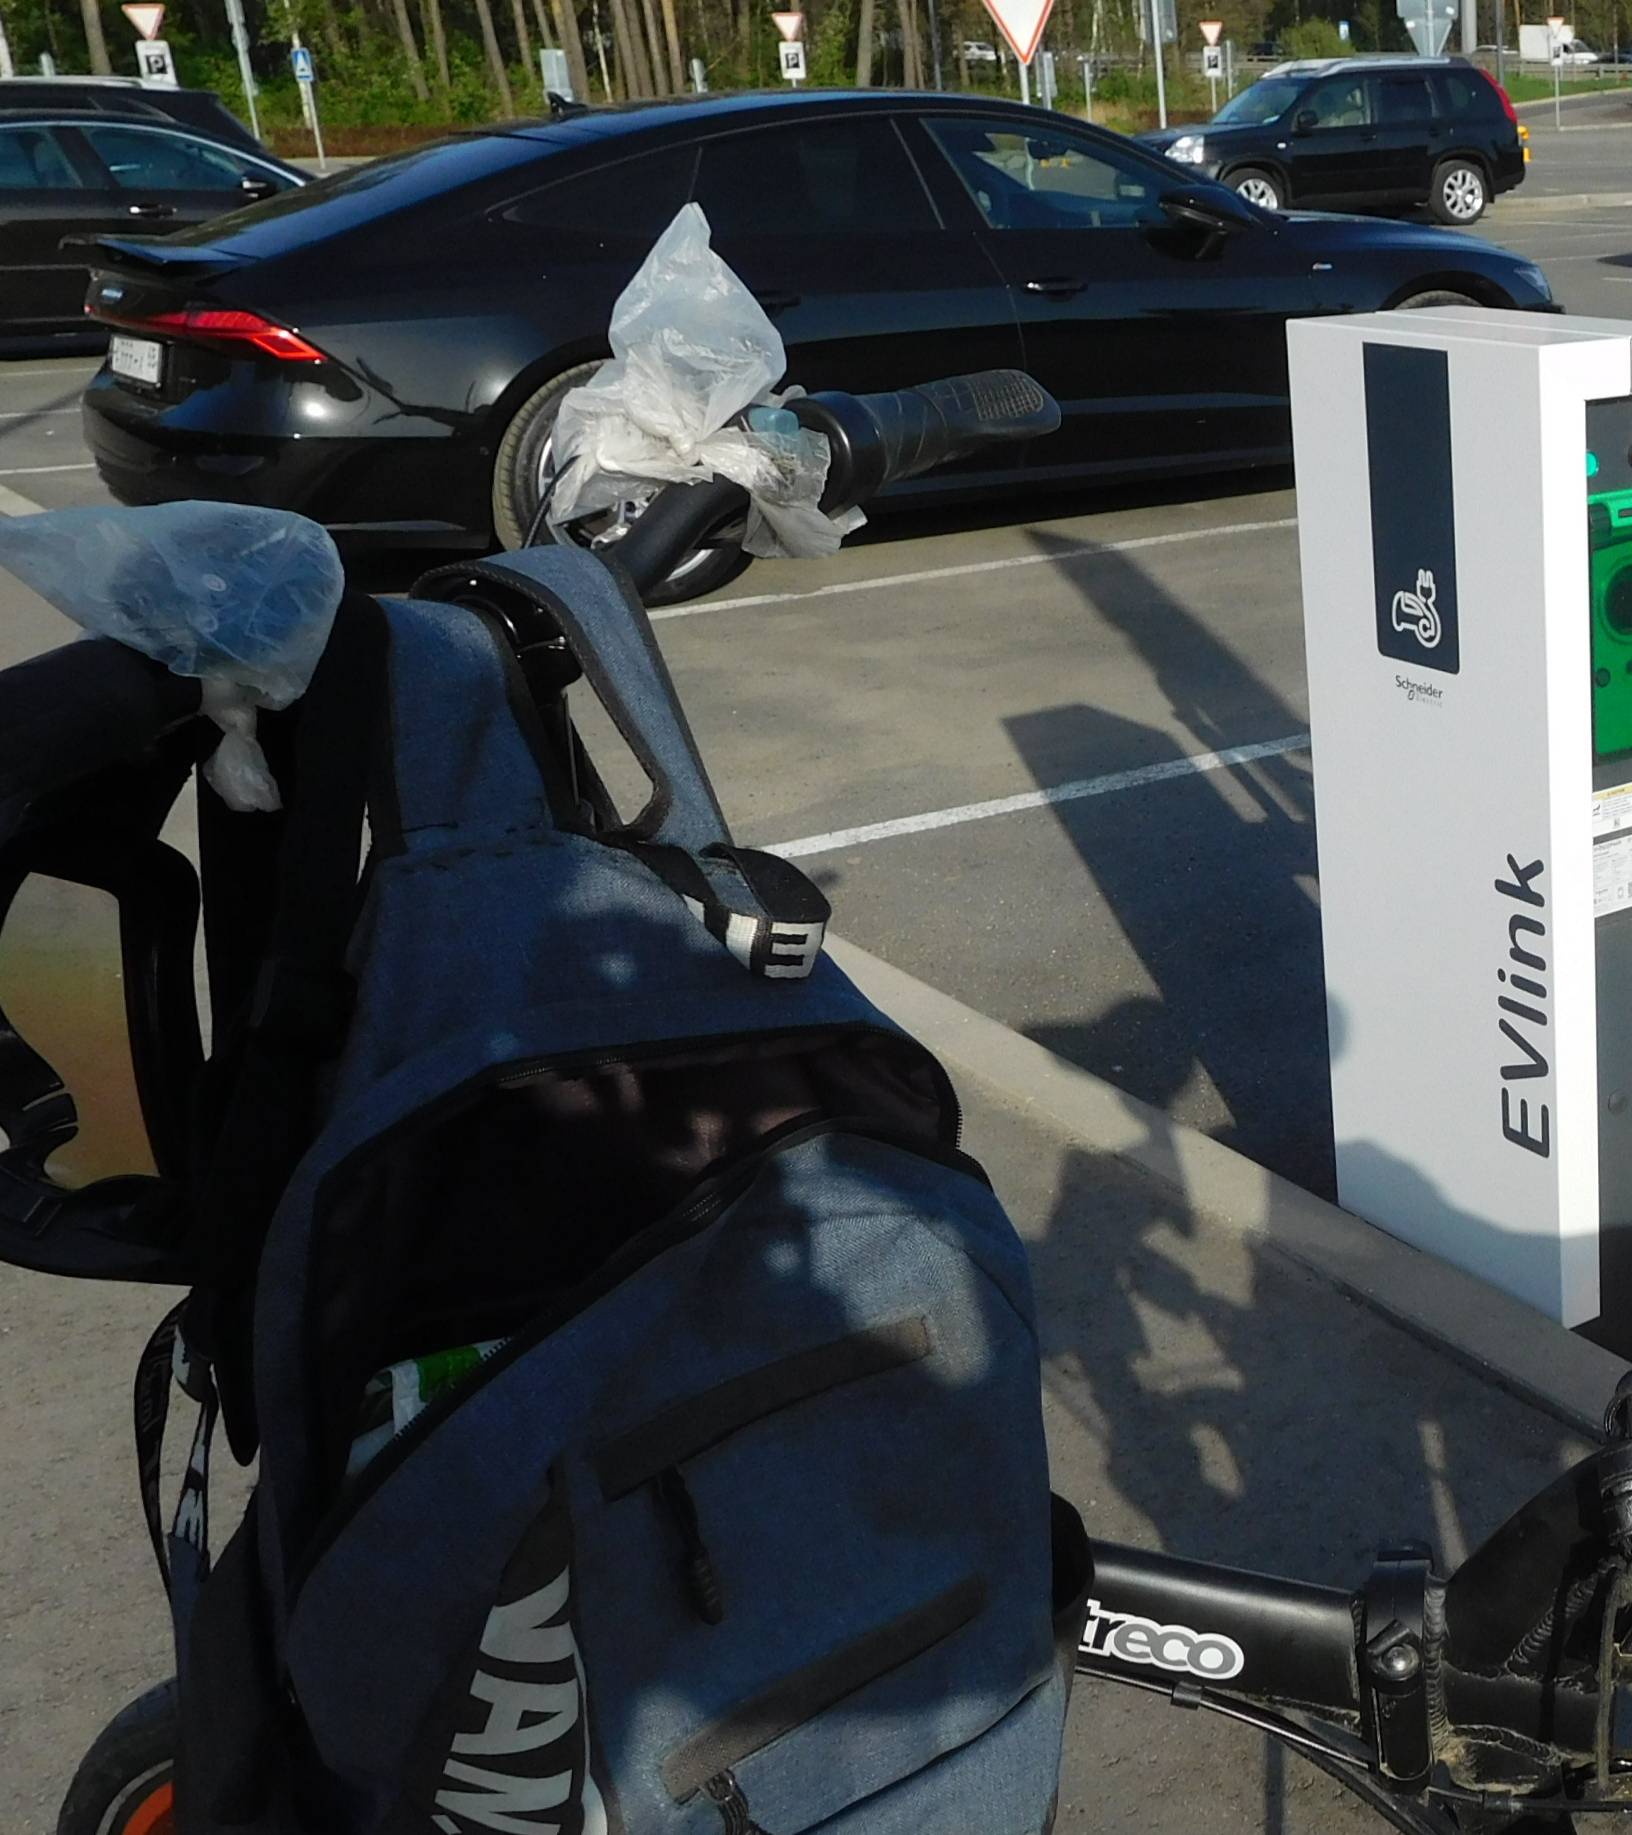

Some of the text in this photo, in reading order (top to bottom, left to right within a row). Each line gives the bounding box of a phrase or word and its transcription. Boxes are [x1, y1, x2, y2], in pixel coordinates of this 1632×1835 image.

[1395, 675, 1443, 699] Schneider
[1495, 853, 1550, 1158] EVlink
[431, 1564, 580, 1835] VAN
